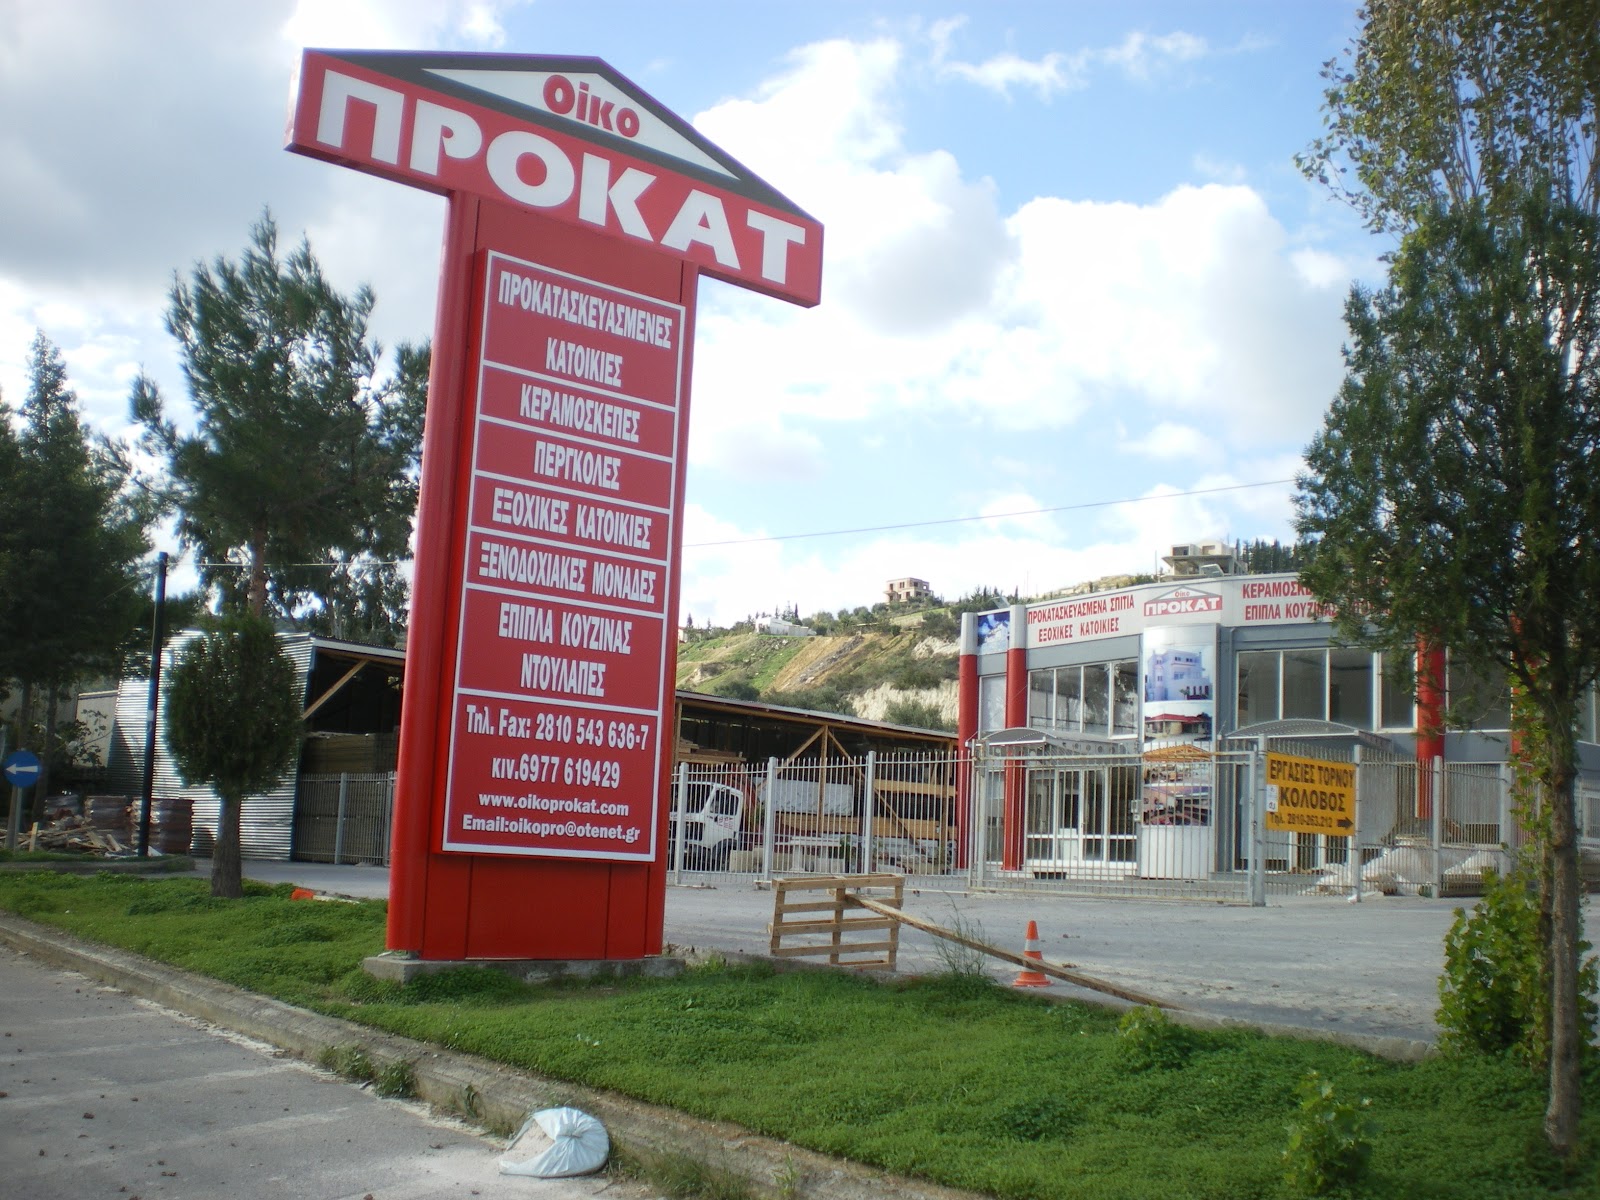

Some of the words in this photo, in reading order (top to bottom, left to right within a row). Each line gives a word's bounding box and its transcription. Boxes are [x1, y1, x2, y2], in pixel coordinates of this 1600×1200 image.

[316, 68, 806, 285] ΠΡΟΚΑΤ
[497, 270, 673, 350] ΠΡΟΚΑΤΑΣΚΕΥΑΣΜΕΝΕΣ
[545, 337, 623, 388] ΚΑΤΟΙΚΙΕΣ
[519, 383, 640, 443] ΚΕΡΑΜΟΣΚΕΠΕΣ
[533, 440, 621, 491] ΠΕΡΓΚΟΛΕΣ
[492, 487, 570, 535] ΕΞΟΧΙΚΕΣ
[575, 503, 652, 550] ΚΑΤΟΙΚΙΕΣ
[479, 541, 587, 593] ΞΕΝΟΔΟΧΙΑΚΕΣ
[591, 561, 657, 604] ΜΟΝΑΔΕΣ
[498, 602, 553, 644] ΕΠΙΠΛΑ
[560, 611, 632, 655] ΚΟΥΖΙΝΑΣ
[1027, 599, 1108, 625] ΠΡΟΚΑΤΑΣΚΕΥΑΣΜΕΝΑ
[1110, 594, 1135, 612] ΣΠΙΤΙΑ
[1145, 597, 1220, 616] ΠΡΟΚΑΤ
[1245, 604, 1281, 620] ΕΠΙΠΛΑ
[1038, 624, 1073, 643] ΕΞΟΧΙΚΕΣ
[1080, 617, 1120, 637] ΚΑΤΟΙΚΙΕΣ
[520, 653, 606, 698] ΝΤΟΥΛΑΠΕΣ
[466, 704, 495, 735] Τηλ.
[498, 708, 531, 739] Fax:
[535, 712, 572, 743] 2810
[576, 717, 604, 747] 543
[608, 721, 649, 750] 636-7
[564, 757, 621, 789] 619429
[1269, 759, 1316, 784] ΕΡΓΑΣΙΕΣ
[1317, 765, 1355, 788] ΤΟΡΝΟΥ
[478, 793, 629, 817] www.oikoprokat.com
[1280, 786, 1346, 812] ΚΟΛΟΒΟΣ
[462, 814, 640, 844] Email:oikopro@otenet.gr
